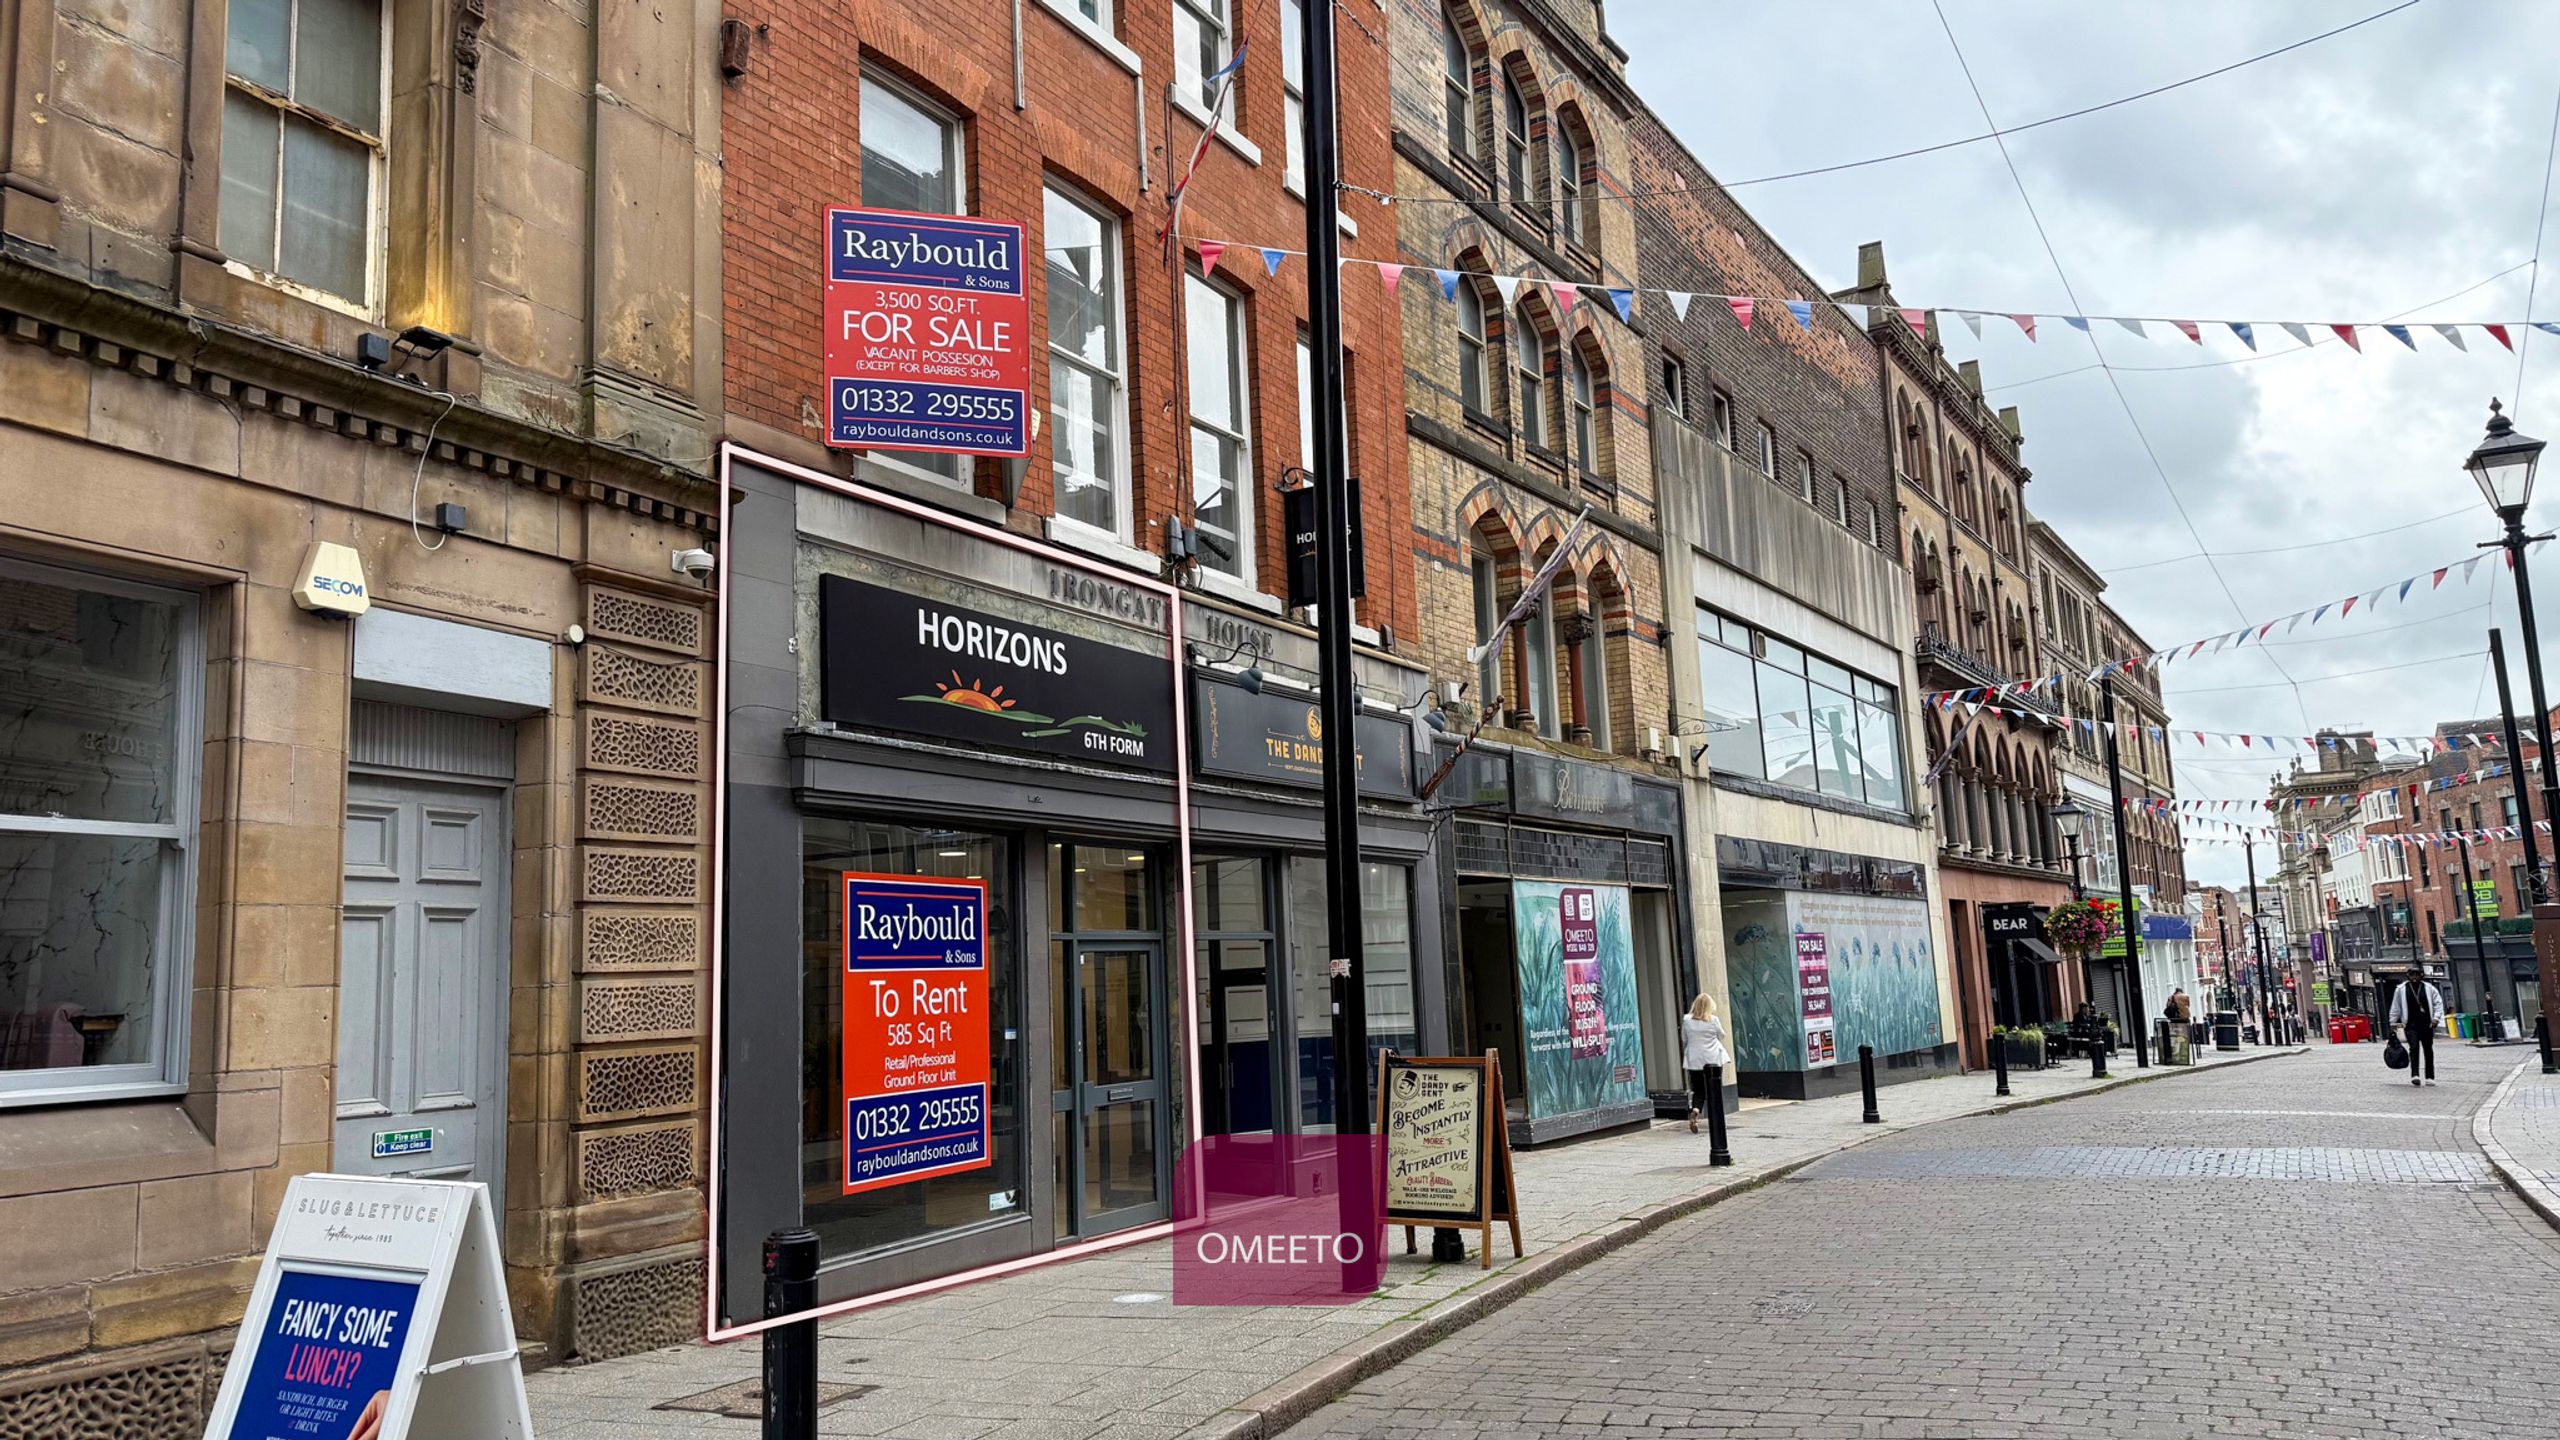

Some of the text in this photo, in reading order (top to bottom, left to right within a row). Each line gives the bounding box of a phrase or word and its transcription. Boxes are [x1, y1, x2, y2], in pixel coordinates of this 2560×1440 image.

[843, 229, 1010, 271] Raybould
[965, 275, 1010, 290] & Sons
[875, 290, 981, 316] 3,500 SQ.FT.
[843, 310, 1011, 353] FOR SALE
[864, 346, 993, 368] VACANT POSSESION
[856, 360, 1001, 381] (EXCEPT FOR BARBERS SHOP)
[841, 387, 1014, 421] 01332 295555
[843, 423, 1013, 445] raybouldandsons.co.uk
[314, 576, 363, 597] SECOM
[918, 608, 1068, 676] HORIZONS
[1207, 615, 1274, 656] HOUSE
[1084, 731, 1144, 757] 6TH FORM
[1266, 738, 1323, 764] THE DAND
[858, 903, 976, 950] Raybould
[1565, 928, 1594, 943] OMEETO
[1993, 917, 2028, 931] BEAR
[945, 950, 976, 963] & Sons
[1799, 940, 1824, 952] FOR SALE
[869, 978, 968, 1018] To Rent
[1571, 983, 1598, 996] GROUND
[1575, 1000, 1596, 1013] FLOOR
[887, 1021, 952, 1048] 585 Sq Ft
[884, 1051, 956, 1071] Retail/Professional
[884, 1069, 956, 1089] Ground Floor Unit
[856, 1095, 979, 1140] 01332 295555
[1393, 1099, 1445, 1130] BECOME
[1410, 1110, 1471, 1139] INSTANTLY
[390, 1141, 427, 1152] Keep clear
[1423, 1137, 1445, 1145] MORE
[857, 1137, 979, 1175] raybouldandsons.co.uk
[1396, 1149, 1468, 1178] ATTRACTIVE
[278, 1298, 398, 1348] FANCY SOME
[284, 1343, 362, 1389] LUNCH?
[279, 1403, 338, 1422] OR LIGHT BITES
[316, 1396, 348, 1411] BURGER
[295, 1420, 320, 1433] DRINK
